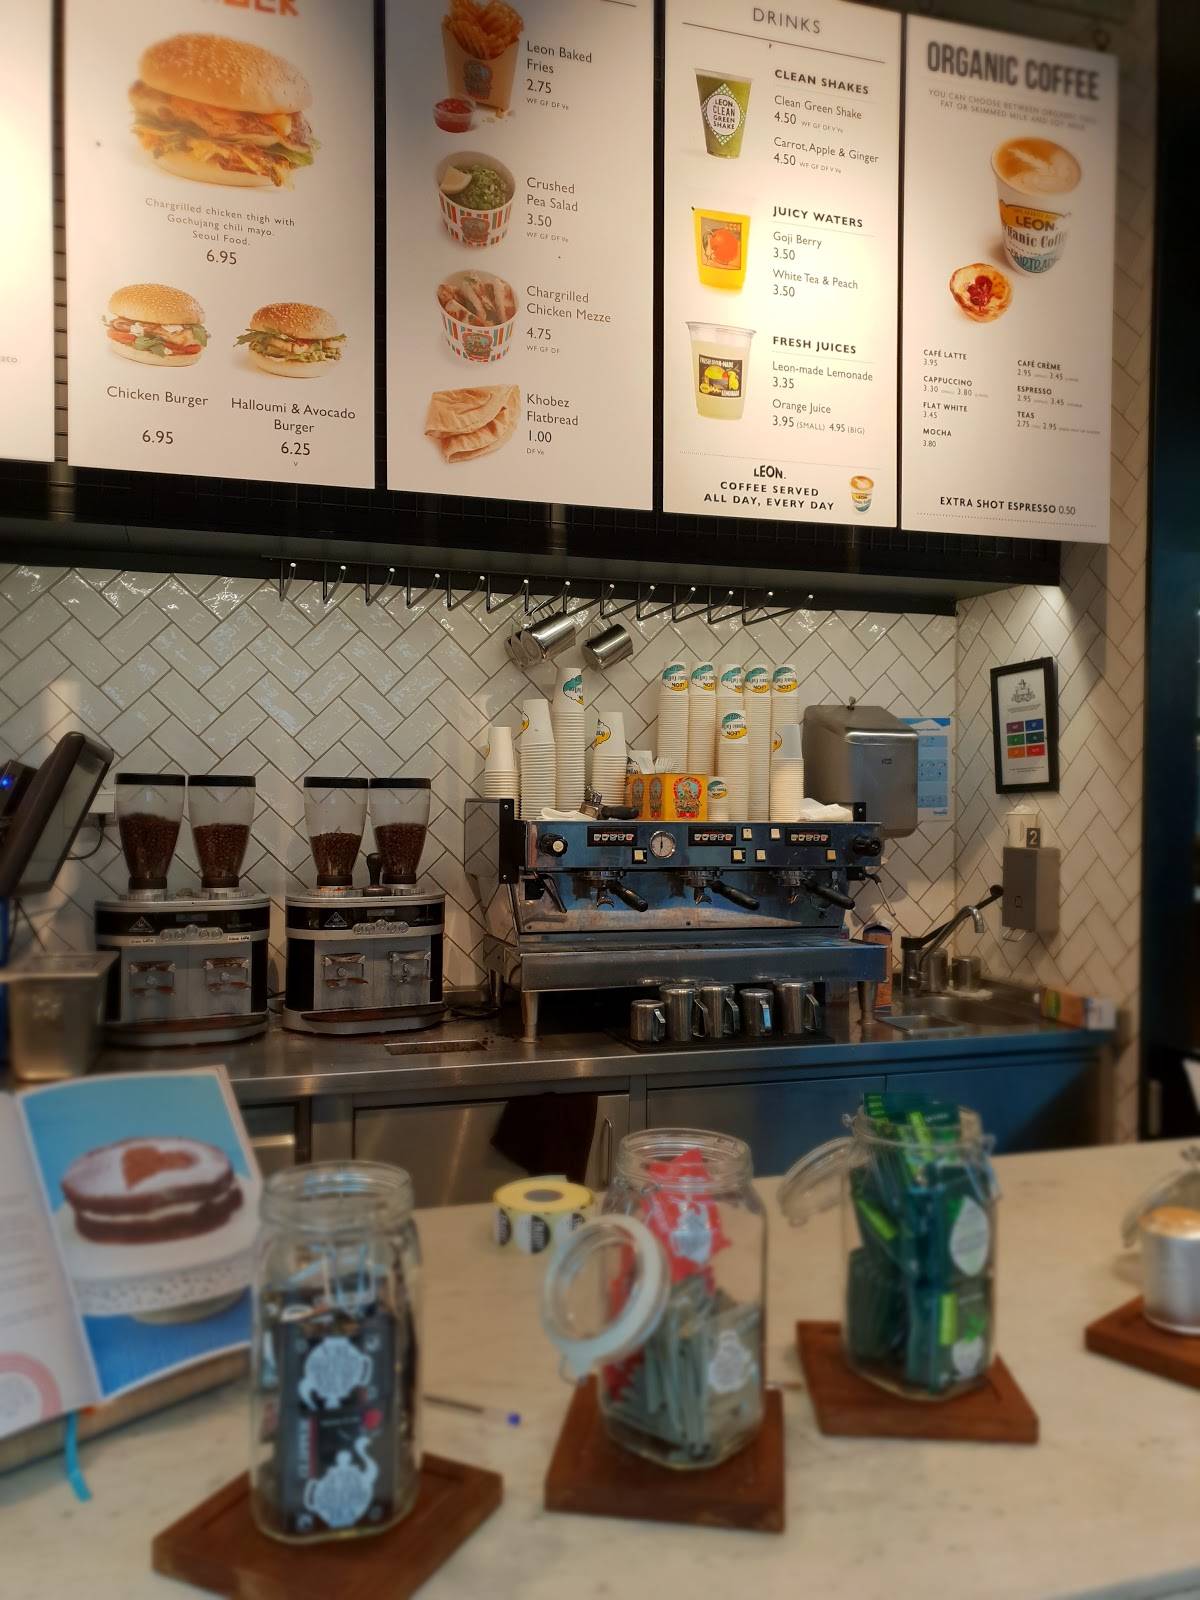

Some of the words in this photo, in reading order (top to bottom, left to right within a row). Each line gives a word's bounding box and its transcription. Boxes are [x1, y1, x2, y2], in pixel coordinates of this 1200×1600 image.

[753, 7, 821, 34] DRINKS
[526, 41, 555, 56] Leon
[559, 47, 592, 64] Baked
[527, 59, 554, 74] Fries
[927, 41, 1018, 86] ORGANIC
[1025, 58, 1100, 101] COFFEE
[526, 79, 552, 94] 2.75
[774, 69, 817, 86] CLEAN
[821, 77, 869, 95] SHAKES
[527, 97, 539, 105] WF
[929, 88, 946, 98] YOU
[948, 91, 966, 101] CAN
[969, 95, 1000, 107] CHOOSE
[713, 104, 735, 117] CLEAN
[774, 95, 801, 109] Clean
[804, 100, 833, 115] Green
[836, 105, 862, 120] Shake
[940, 100, 954, 109] FAT
[957, 103, 968, 111] OR
[971, 105, 1007, 118] SKIMMED
[713, 114, 735, 123] GREEN
[713, 120, 735, 130] SHAKE
[774, 111, 797, 125] 4.50
[774, 153, 796, 166] 4.50
[839, 148, 846, 158] &
[849, 149, 879, 165] Ginger
[527, 177, 575, 194] Crushed
[527, 194, 546, 208] Pea
[550, 198, 578, 212] Salad
[145, 198, 202, 213] Chargrilled
[205, 207, 243, 219] chicken
[246, 212, 270, 224] thigh
[274, 217, 296, 227] with
[773, 206, 808, 220] JUICY
[813, 212, 863, 228] WATERS
[167, 214, 220, 231] Gochujang
[223, 221, 243, 232] chili
[527, 213, 552, 228] 3.50
[192, 230, 219, 241] Seoul
[223, 234, 251, 246] Food.
[527, 231, 538, 239] WF
[773, 231, 793, 245] Goji
[796, 235, 822, 249] Berry
[206, 249, 237, 265] 6.95
[773, 247, 795, 260] 3.50
[773, 268, 802, 282] White
[804, 273, 819, 285] Tea
[822, 275, 829, 286] &
[832, 277, 858, 289] Peach
[526, 285, 589, 304] Chargrilled
[773, 284, 795, 297] 3.50
[526, 303, 572, 319] Chicken
[577, 308, 612, 323] Mezze
[526, 328, 552, 341] 4.75
[527, 344, 538, 352] WF
[773, 336, 811, 349] FRESH
[816, 340, 856, 354] JUICES
[923, 358, 938, 366] 3.95
[944, 351, 967, 360] LATTE
[772, 361, 823, 376] Leon-made
[827, 367, 873, 382] Lemonade
[772, 377, 794, 389] 3.35
[923, 375, 972, 387] CAPPUCCINO
[923, 384, 939, 393] 3.30
[106, 385, 161, 404] Chicken
[165, 390, 208, 410] Burger
[1017, 385, 1052, 395] ESPRESSO
[527, 393, 570, 408] Khobez
[772, 399, 807, 413] Orange
[810, 400, 831, 414] Juice
[944, 403, 968, 412] WHITE
[231, 397, 287, 414] Halloumi
[291, 402, 301, 415] &
[304, 404, 356, 421] Avocado
[923, 411, 937, 419] 3.45
[1017, 411, 1035, 419] TEAS
[527, 411, 579, 426] Flatbread
[772, 415, 794, 428] 3.95
[796, 421, 826, 431] (SMALL)
[829, 423, 846, 433] 4.95
[847, 426, 865, 435] (BIG)
[274, 418, 315, 435] Burger
[923, 428, 952, 437] MOCHA
[142, 429, 174, 446] 6.95
[528, 430, 552, 443] 1.00
[923, 440, 937, 448] 3.80
[280, 442, 311, 457] 6.25
[720, 481, 767, 493] COFFEE
[772, 485, 819, 496] SERVED
[704, 493, 727, 502] ALL
[733, 495, 761, 507] DAY,
[766, 498, 805, 509] EVERY
[810, 501, 834, 511] DAY
[940, 497, 973, 507] EXTRA
[976, 499, 1004, 509] SHOT
[1008, 502, 1056, 513] ESPRESSO
[1058, 506, 1076, 516] 0.50
[1029, 830, 1038, 846] 2
